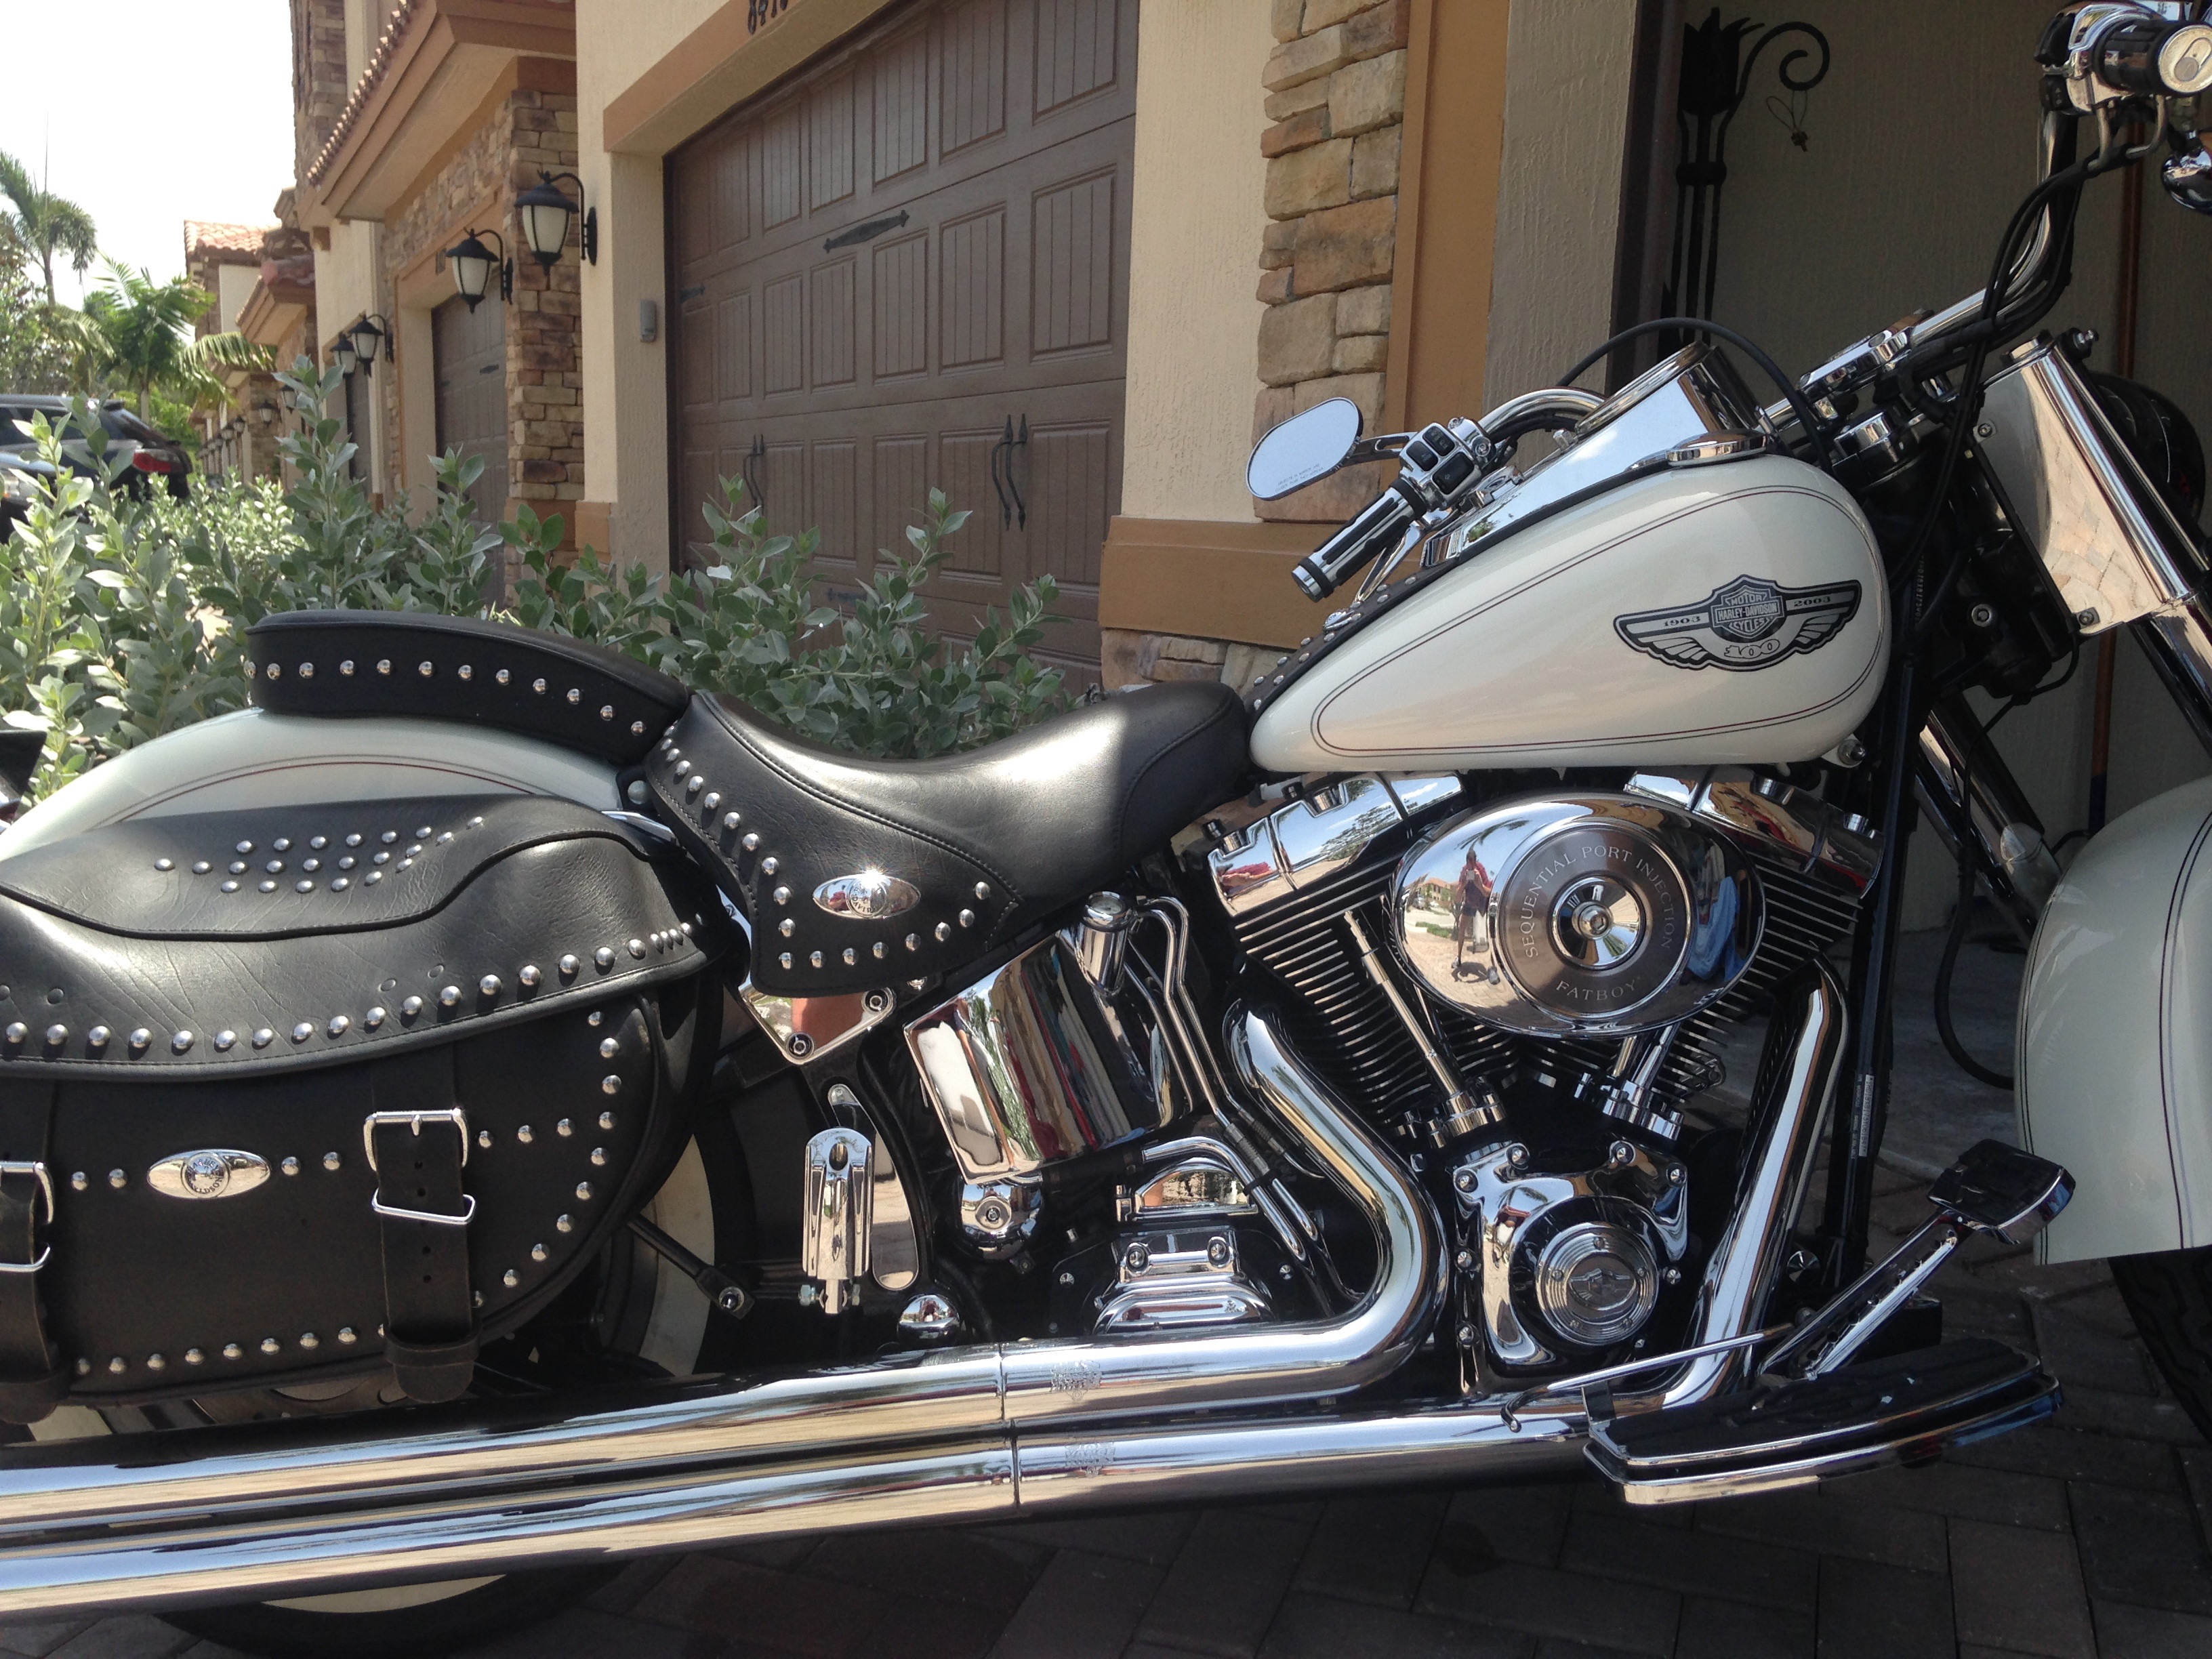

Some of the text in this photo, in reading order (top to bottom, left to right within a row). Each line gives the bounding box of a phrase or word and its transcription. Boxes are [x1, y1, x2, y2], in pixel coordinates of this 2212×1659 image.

[1731, 592, 1763, 605] MOTOR
[1793, 596, 1831, 607] 2003
[1717, 602, 1778, 621] HARLEY-DAVIDSON
[1664, 616, 1701, 627] 1903
[1734, 617, 1765, 632] CYCLES
[1724, 638, 1780, 659] 100
[1520, 845, 1675, 958] SEQUENTIAL PORT INJECTION
